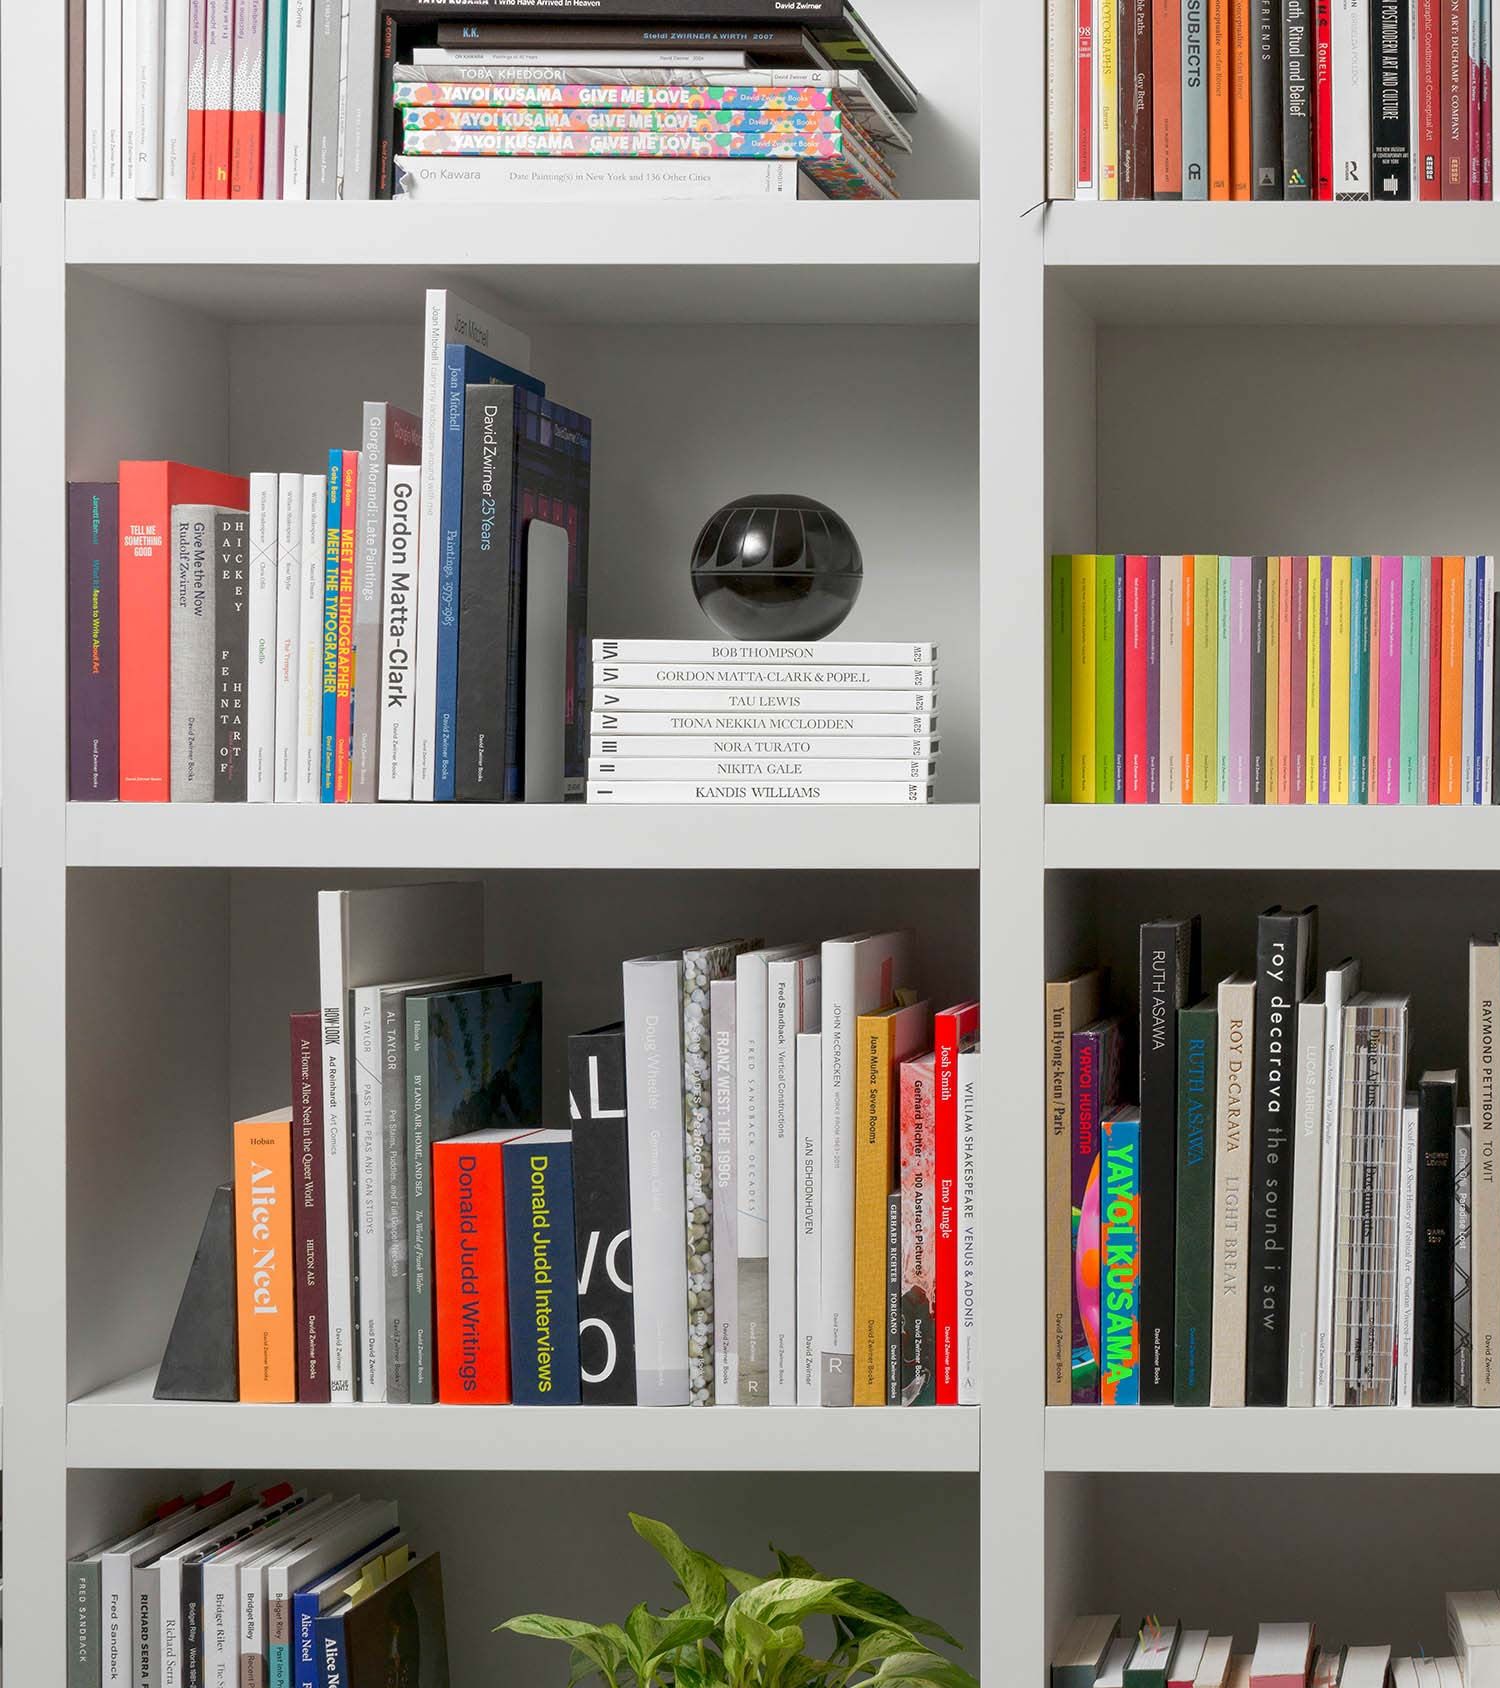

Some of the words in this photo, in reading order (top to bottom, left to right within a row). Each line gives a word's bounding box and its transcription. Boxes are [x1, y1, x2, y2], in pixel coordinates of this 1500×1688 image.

[775, 2, 795, 10] David
[796, 2, 822, 11] Zwirner
[463, 28, 479, 38] K.K.
[1187, 0, 1200, 88] SUBJECTS
[1288, 27, 1304, 57] Ritual
[1382, 6, 1398, 54] POSTMODERN
[460, 68, 494, 79] TOBA
[498, 68, 566, 80] KHEDOORI
[1288, 61, 1304, 78] and
[1382, 56, 1398, 69] ART
[1382, 71, 1398, 86] AND
[441, 87, 490, 102] YAYOI
[493, 87, 562, 102] KUSAMA
[579, 89, 618, 103] GIVE
[620, 89, 644, 103] ME
[648, 89, 690, 104] LOVE
[1288, 81, 1304, 117] Belief
[1382, 89, 1398, 119] CULTURE
[420, 169, 439, 180] On
[442, 169, 481, 180] Kawara
[482, 405, 497, 444] David
[482, 447, 495, 497] Zwirner
[390, 482, 412, 565] Gordon
[481, 498, 495, 515] 25
[124, 536, 162, 546] SOMETHING
[130, 525, 142, 535] TELL
[144, 525, 156, 535] ME
[178, 522, 190, 559] Rudolf
[193, 522, 205, 548] Give
[341, 529, 354, 564] MEET
[480, 516, 494, 550] Years
[134, 547, 152, 557] GOOD
[193, 550, 205, 568] Me
[178, 562, 190, 607] Zwirner
[193, 569, 205, 587] the
[340, 566, 354, 593] THE
[193, 589, 205, 616] Now
[337, 595, 353, 697] LITHOGRAPHER
[387, 572, 410, 708] Matta-Clark
[712, 647, 738, 658] BOB
[739, 647, 814, 658] THOMPSON
[657, 671, 714, 682] GORDON
[717, 671, 812, 682] MATTA-CLARK
[827, 671, 870, 682] POPE.L
[729, 696, 756, 706] TAU
[759, 696, 801, 707] LEWIS
[671, 718, 713, 729] TIONA
[715, 718, 767, 729] NEKKIA
[770, 718, 854, 729] MCCLODDEN
[714, 742, 753, 752] NORA
[755, 742, 810, 752] TURATO
[717, 764, 763, 774] NIKITA
[767, 764, 802, 774] GALE
[696, 786, 747, 798] KANDIS
[751, 786, 820, 798] WILLIAMS
[1151, 950, 1166, 993] RUTH
[1267, 943, 1284, 981] roy
[1151, 997, 1166, 1050] ASAWA
[1482, 1000, 1493, 1064] RAYMOND
[939, 1045, 952, 1068] Josh
[1267, 996, 1290, 1114] decarava
[941, 1070, 952, 1101] Smith
[1482, 1067, 1493, 1130] PETTIBON
[963, 1082, 974, 1132] WILLIAM
[529, 1155, 551, 1227] Donald
[963, 1136, 974, 1218] SHAKESPEARE
[1107, 1144, 1133, 1236] YAYOI
[249, 1159, 278, 1240] Alice
[457, 1155, 478, 1235] Donald
[459, 1238, 480, 1295] Judd
[530, 1231, 553, 1284] Judd
[252, 1247, 278, 1317] Neel
[1107, 1244, 1133, 1384] KUSAMA
[457, 1300, 481, 1392] Writings
[533, 1288, 555, 1392] Interviews
[110, 1593, 119, 1620] Fred
[109, 1623, 119, 1680] Sandback
[324, 1638, 337, 1671] Alice
